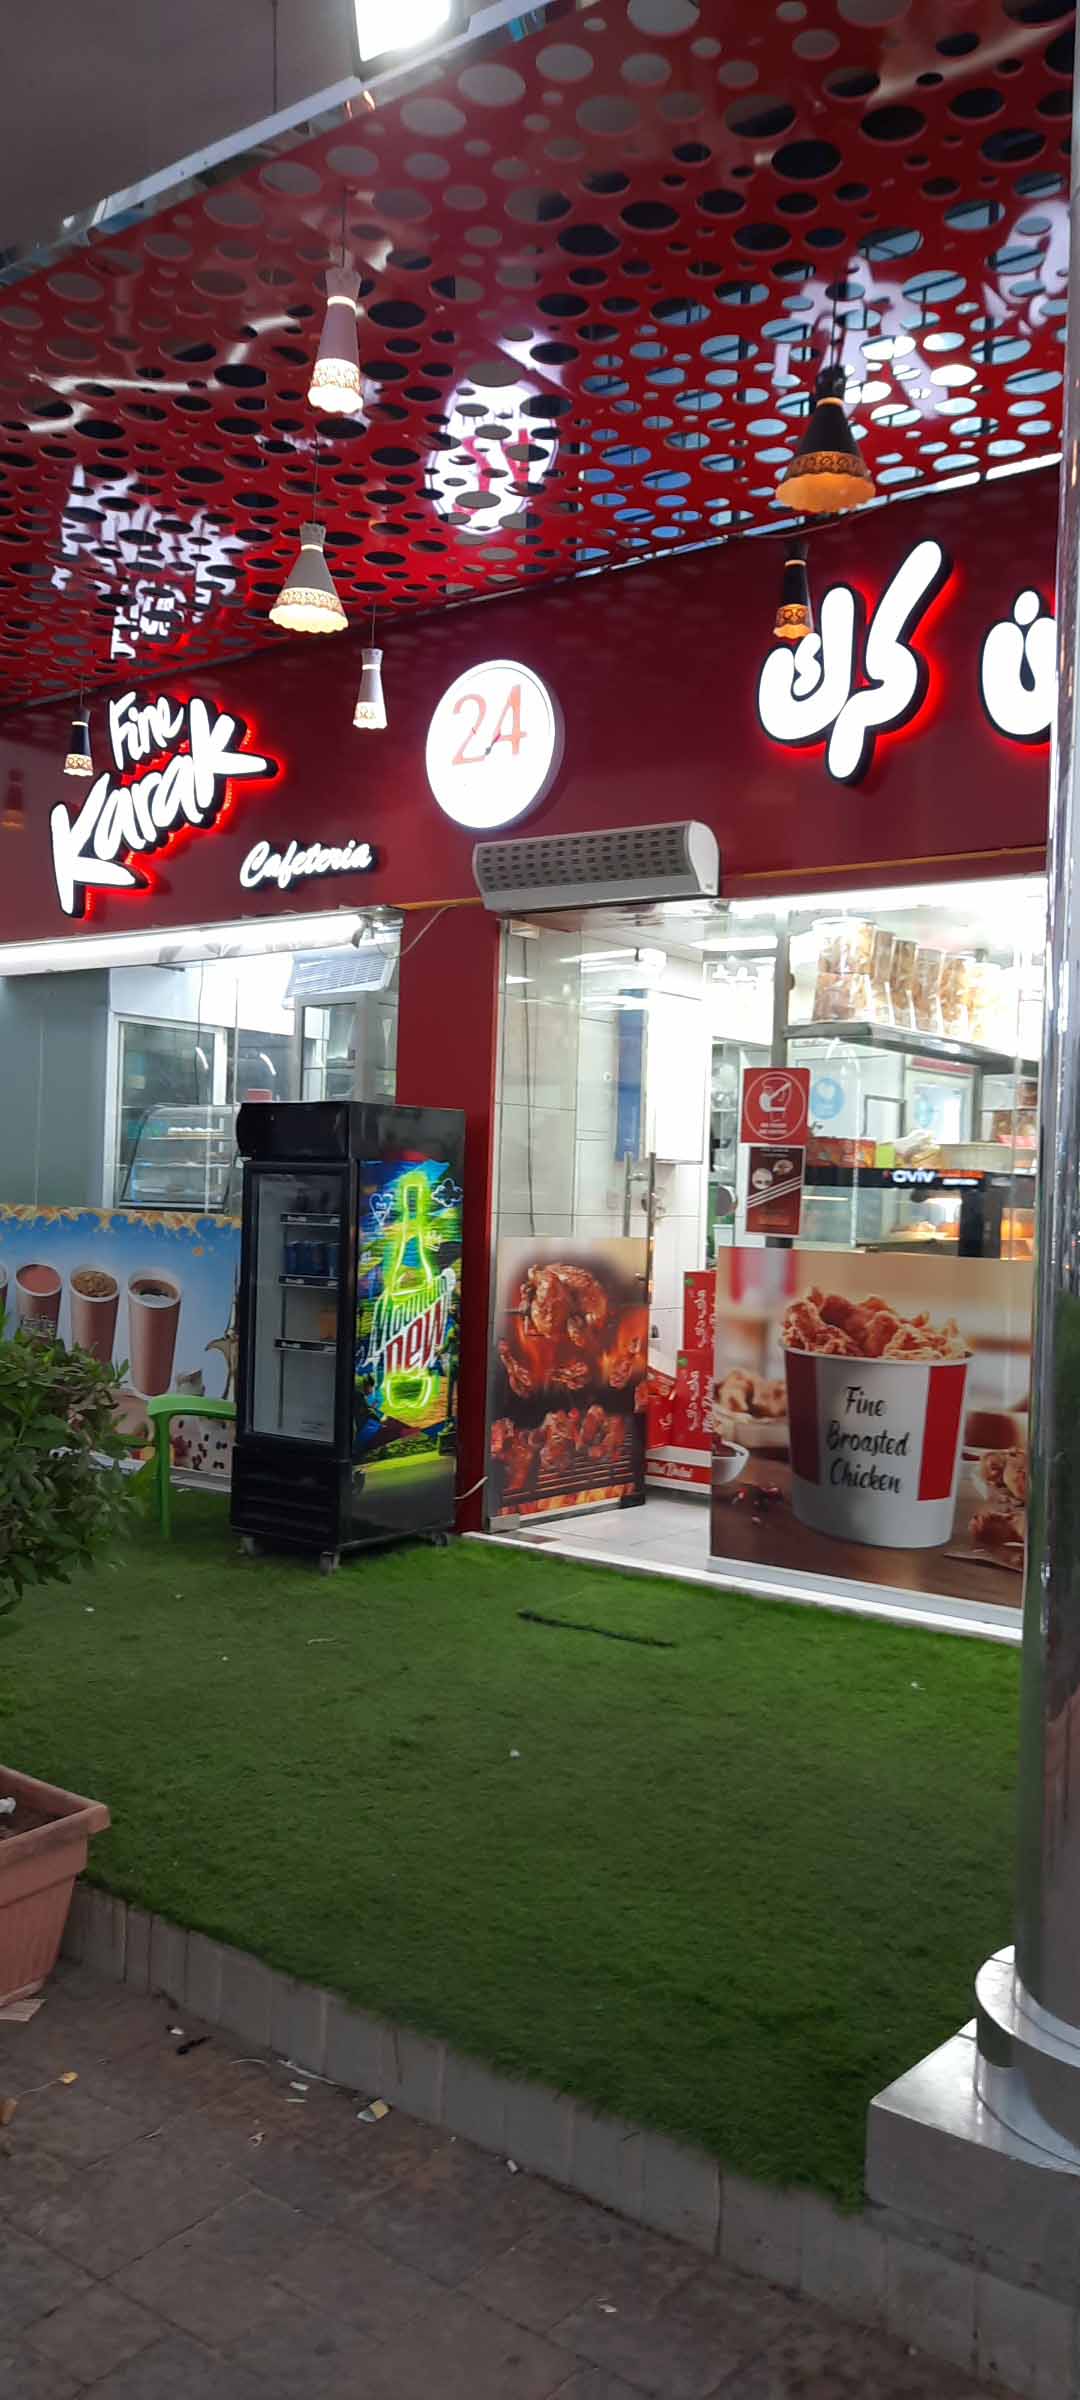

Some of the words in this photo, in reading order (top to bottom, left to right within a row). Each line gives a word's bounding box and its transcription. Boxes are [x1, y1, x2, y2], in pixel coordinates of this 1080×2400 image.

[758, 540, 944, 779] كرك
[108, 691, 184, 771] Fine
[452, 684, 528, 765] 24
[240, 839, 373, 888] Cafeteria
[845, 1386, 886, 1416] Fine
[827, 1420, 910, 1456] Broasted
[830, 1457, 902, 1493] Chicken
